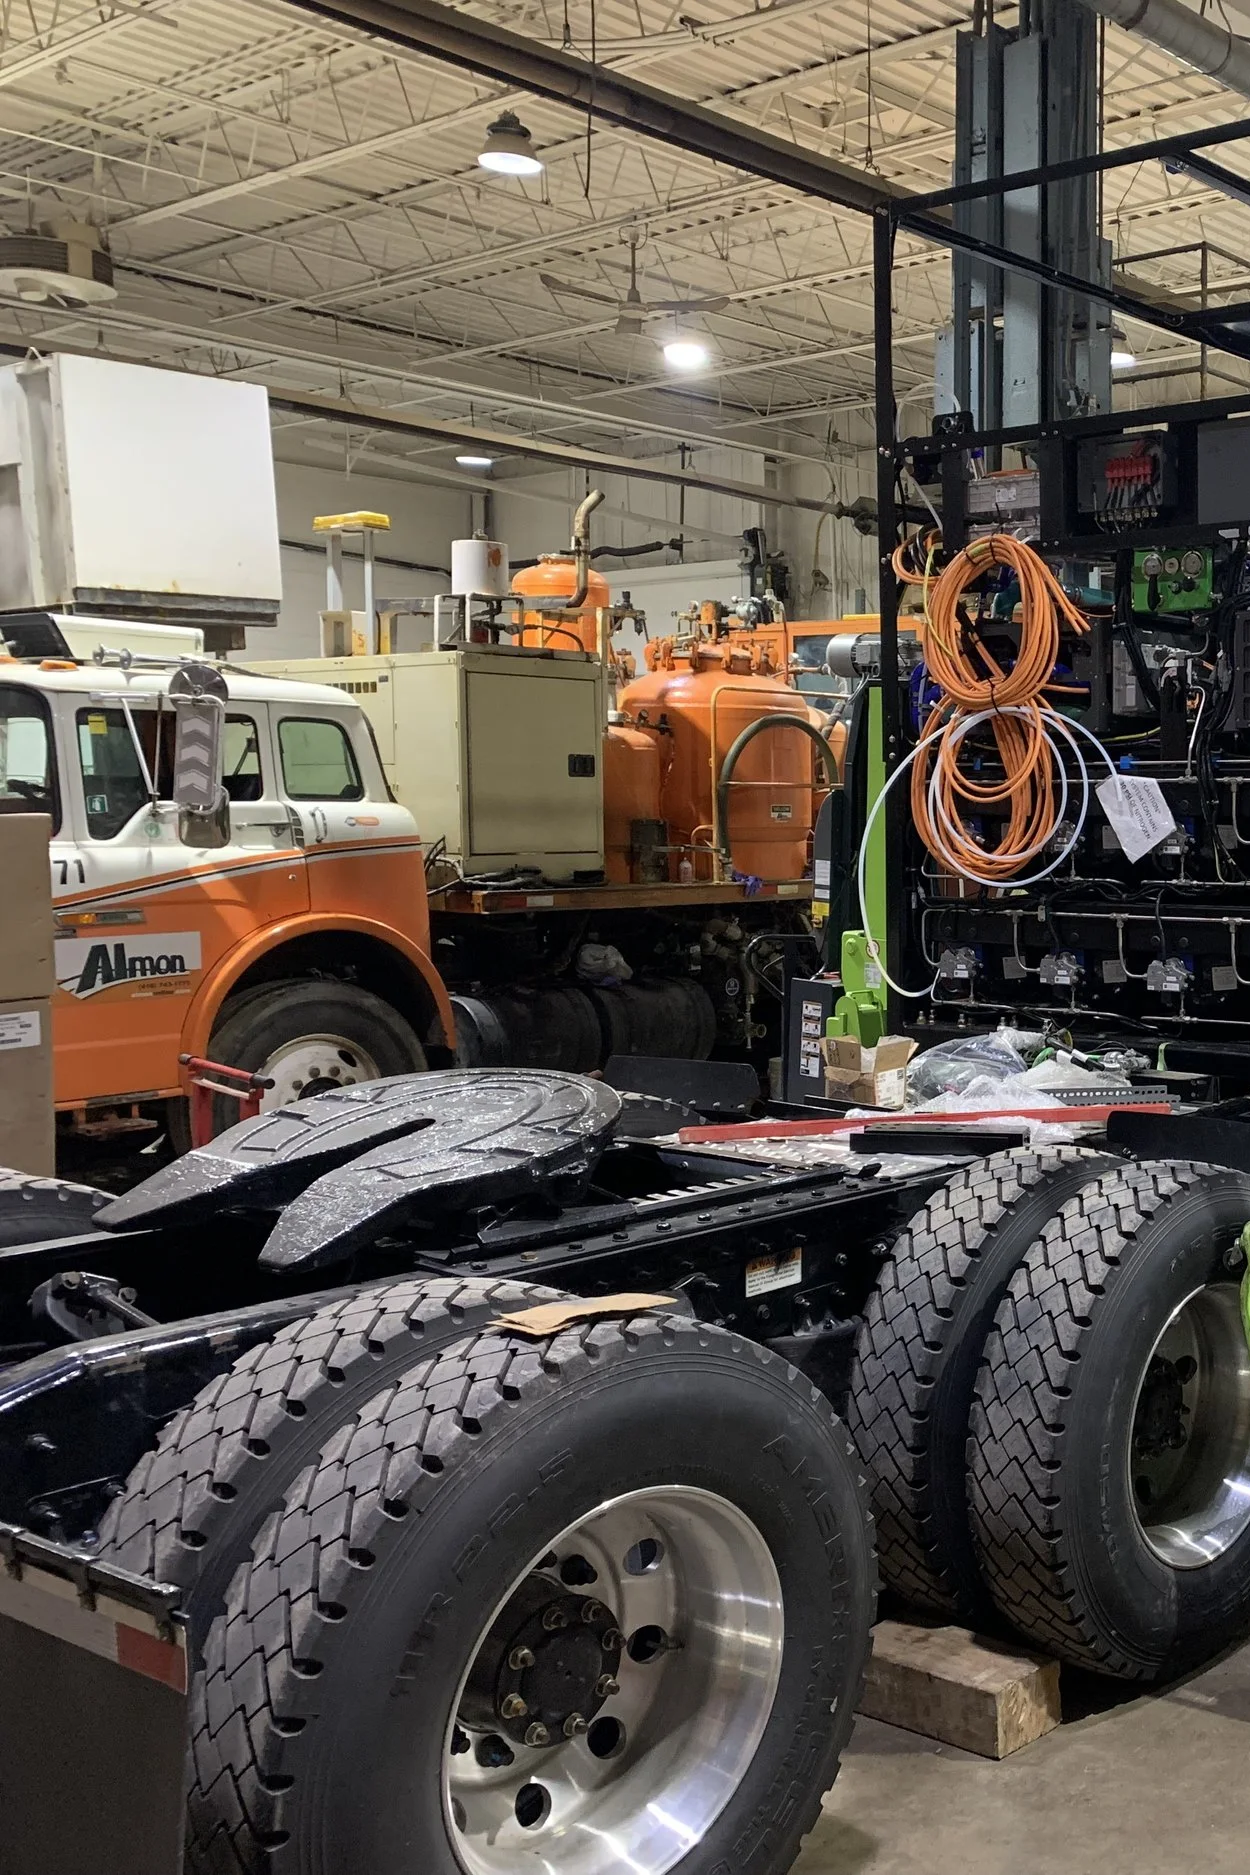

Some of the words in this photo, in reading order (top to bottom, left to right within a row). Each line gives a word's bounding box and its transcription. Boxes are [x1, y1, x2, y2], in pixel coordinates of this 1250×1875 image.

[1134, 808, 1151, 840] NITROGEN
[52, 859, 85, 884] 71
[75, 943, 187, 994] Almon
